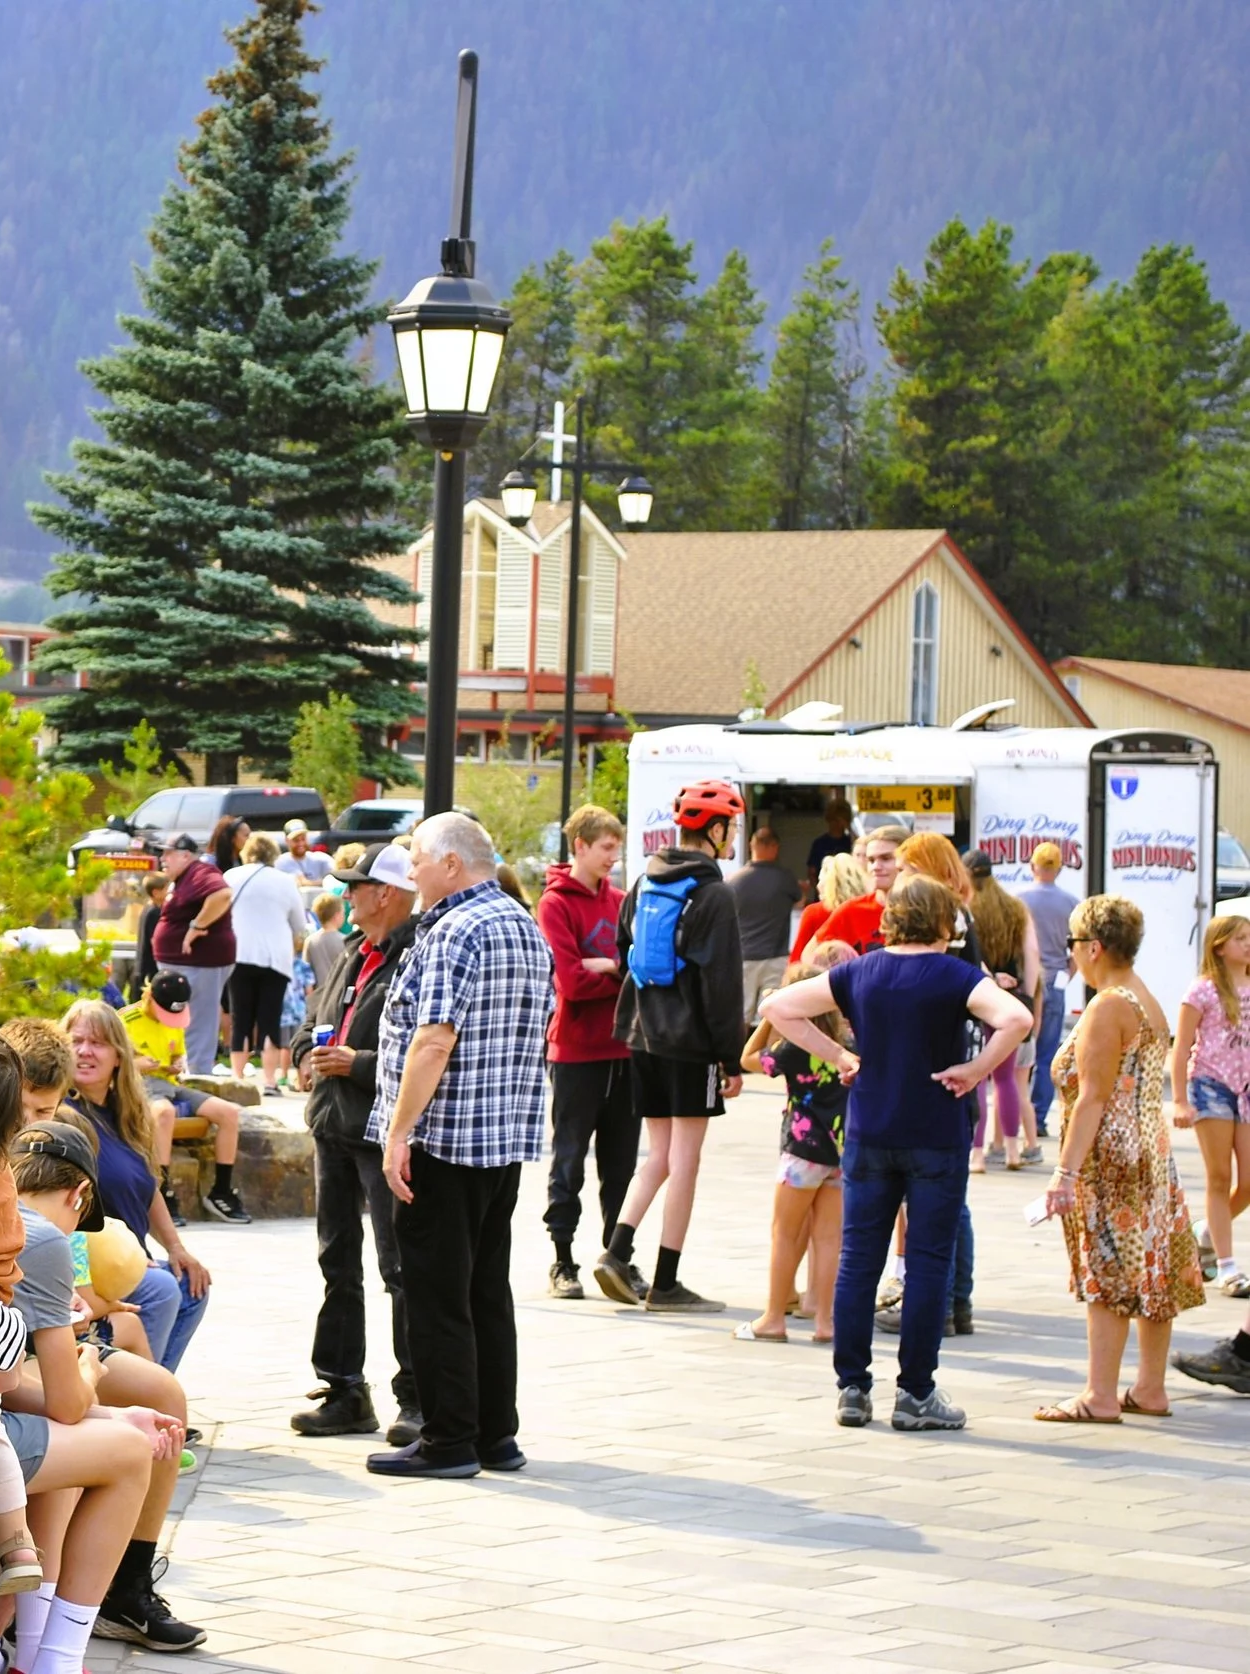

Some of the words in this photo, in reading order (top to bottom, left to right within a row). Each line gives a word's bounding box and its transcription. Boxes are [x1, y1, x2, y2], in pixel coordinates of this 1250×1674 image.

[859, 788, 882, 799] COLD
[859, 800, 906, 811] LEMONADE
[646, 807, 674, 826] Din
[982, 814, 1027, 835] Ding
[1031, 813, 1079, 838] Dong
[1116, 829, 1152, 845] Ding
[1157, 829, 1196, 848] Dong
[979, 836, 1017, 865] MINI
[1112, 845, 1143, 869] MINI
[1145, 844, 1196, 872] DONUTS
